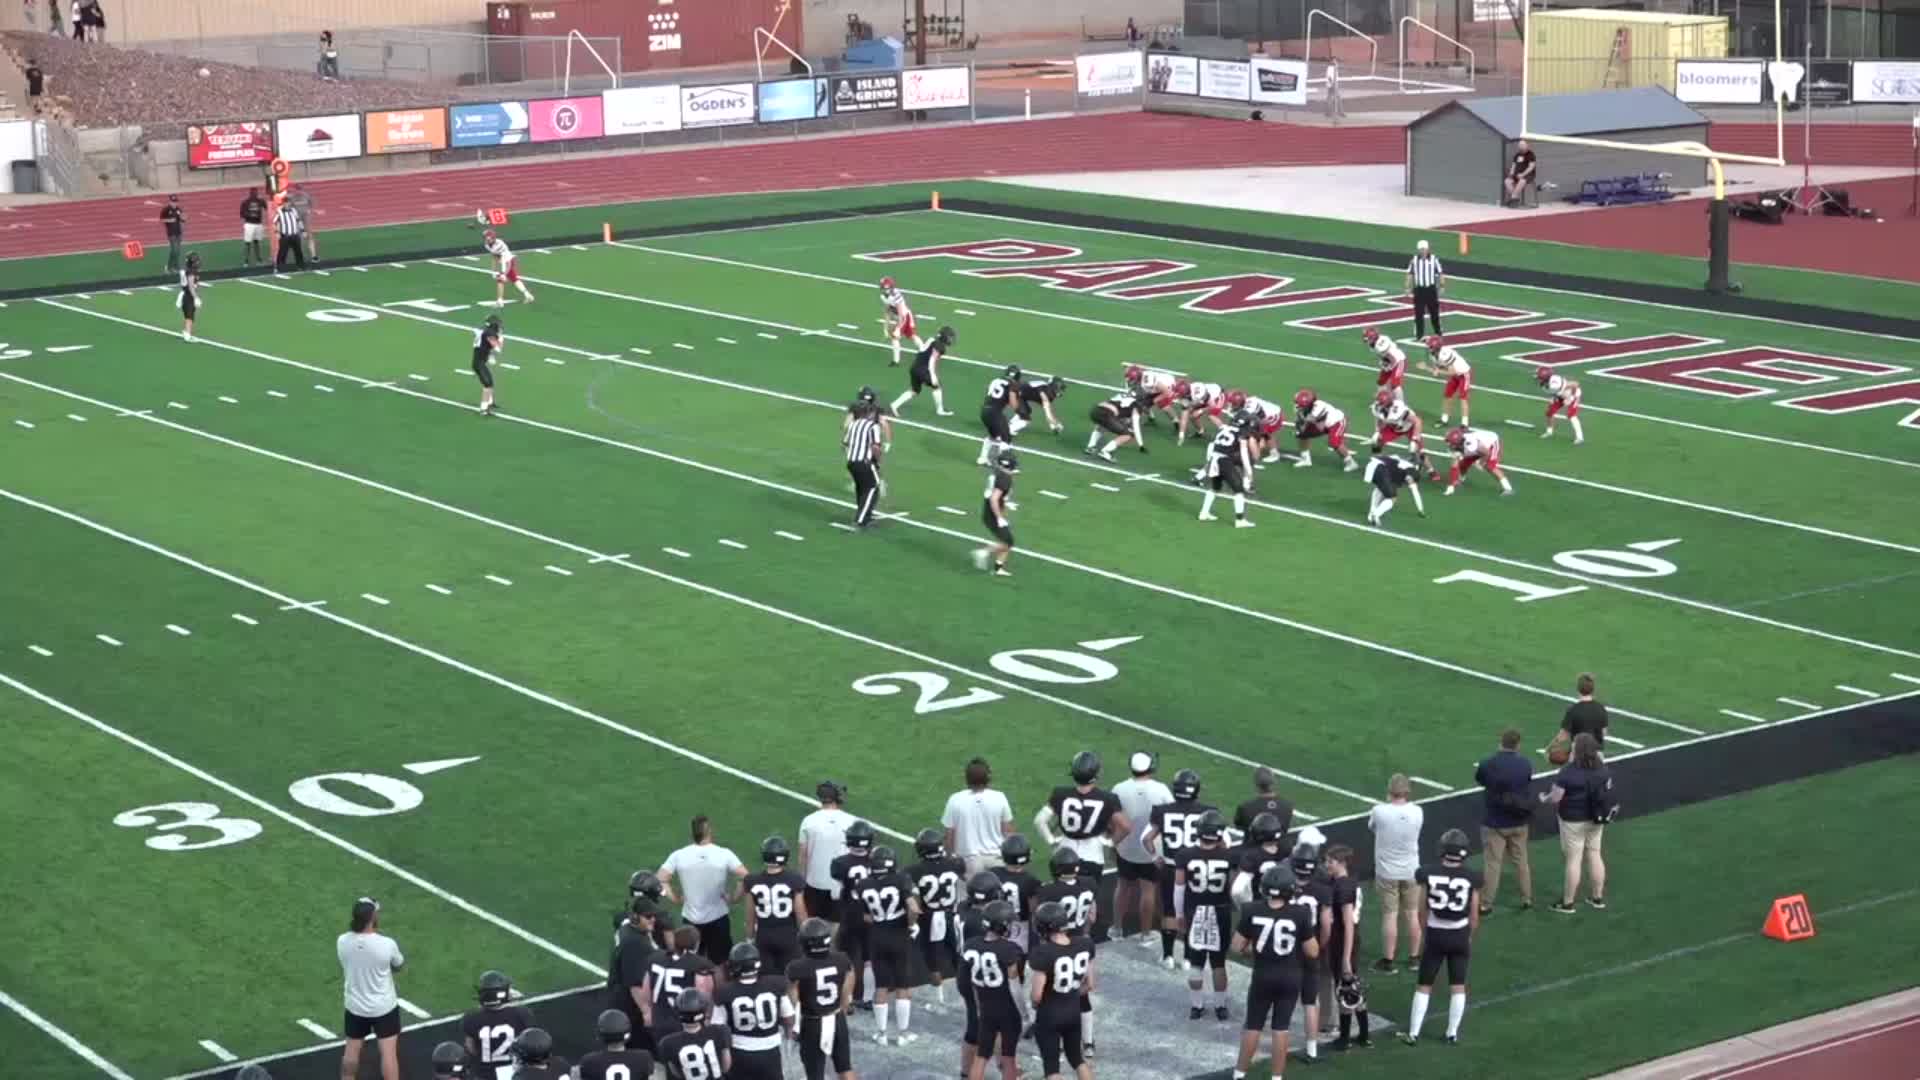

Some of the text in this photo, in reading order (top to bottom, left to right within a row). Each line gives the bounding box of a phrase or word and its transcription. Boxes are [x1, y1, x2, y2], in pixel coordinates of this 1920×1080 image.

[649, 34, 681, 51] ZIM
[855, 88, 898, 102] GRINDS
[856, 77, 897, 91] ISLAND
[1679, 72, 1759, 86] bloomers
[690, 97, 747, 112] OGDEN'S
[852, 648, 1118, 714] 20
[113, 771, 424, 851] 30
[1060, 798, 1105, 834] 67
[919, 871, 959, 909] 23
[1186, 859, 1230, 894] 35
[1426, 874, 1471, 913] 53
[751, 883, 793, 919] 36
[861, 885, 905, 922] 82
[1060, 889, 1094, 929] 26
[1780, 900, 1810, 935] 20
[1251, 915, 1297, 956] 76
[651, 963, 685, 1007] 75
[815, 965, 839, 1006] 5
[962, 948, 1004, 988] 28
[1053, 950, 1091, 994] 89
[731, 991, 778, 1031] 60
[478, 1023, 516, 1063] 12
[678, 1039, 722, 1080] 81
